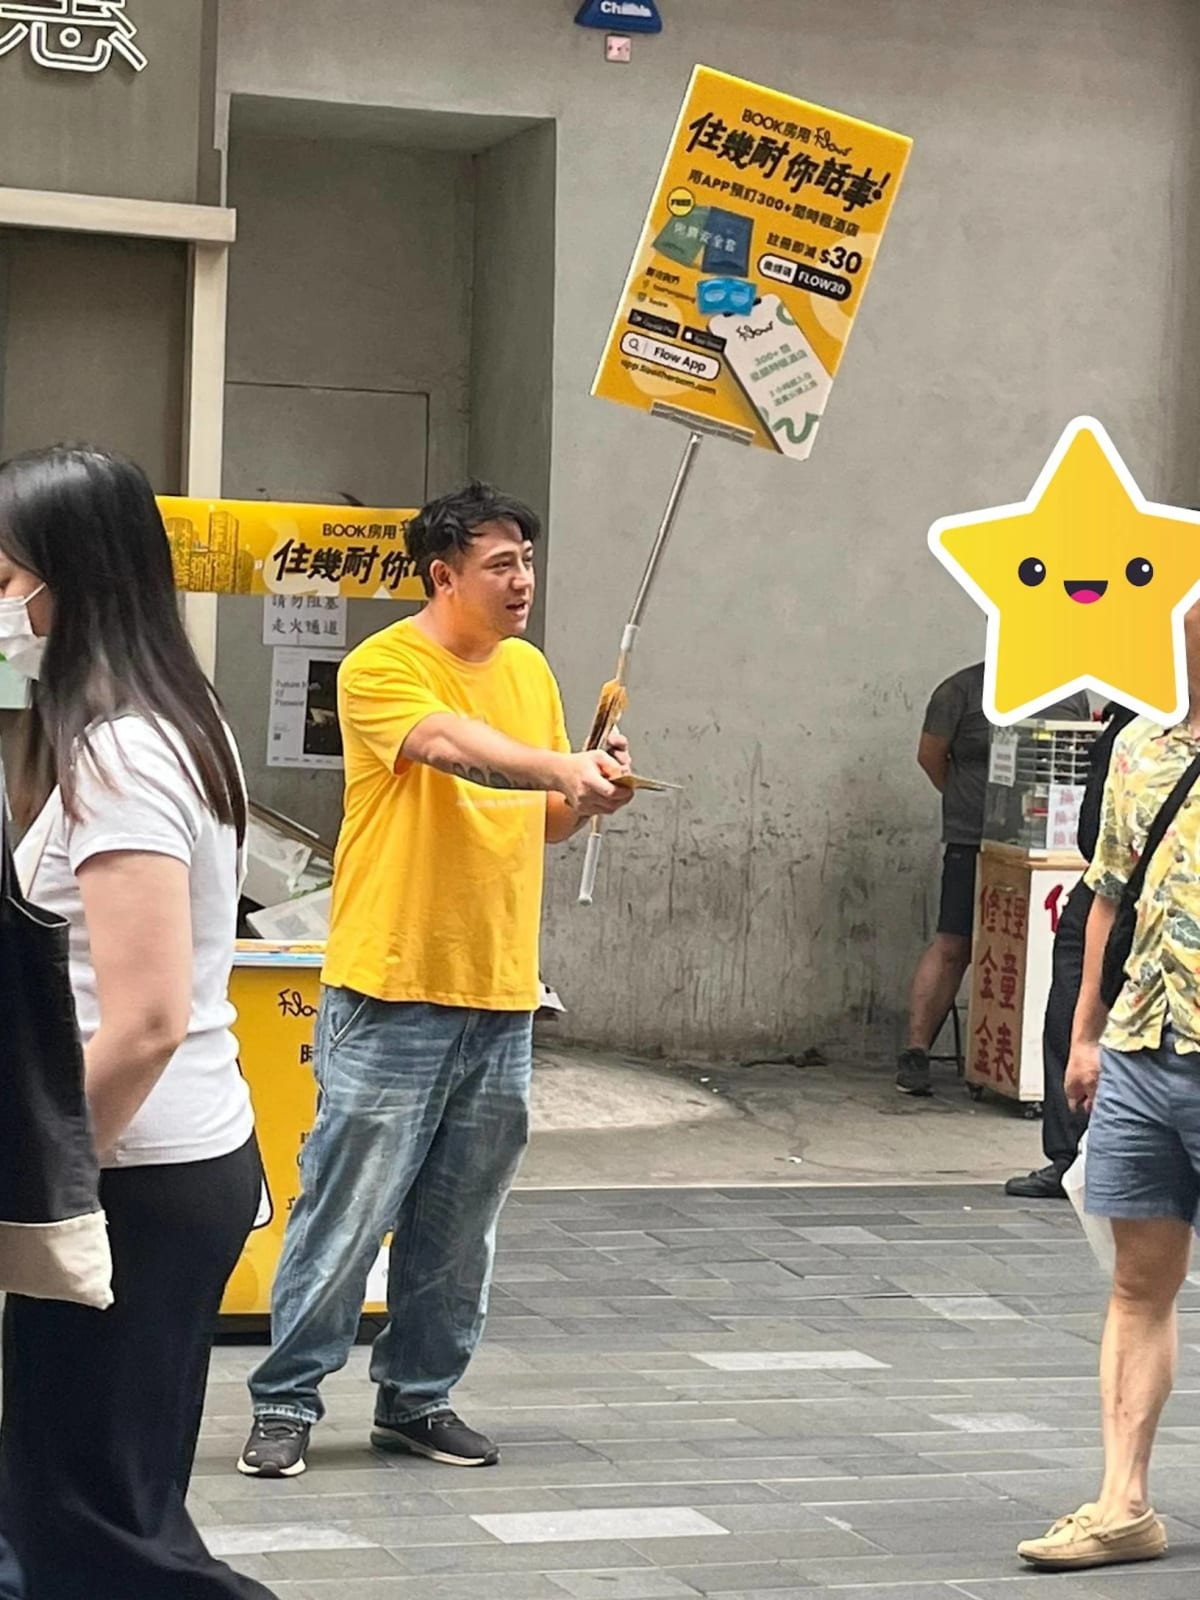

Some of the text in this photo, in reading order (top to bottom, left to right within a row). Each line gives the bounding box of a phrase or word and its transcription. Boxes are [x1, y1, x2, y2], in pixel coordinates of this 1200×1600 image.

[819, 246, 863, 274] $30
[798, 271, 846, 295] FLOW30
[654, 347, 707, 374] Flow App
[323, 523, 397, 538] BOOK房用
[273, 539, 422, 590] 住幾耐你
[272, 617, 339, 636] 走火通道
[278, 988, 319, 1017] Flo
